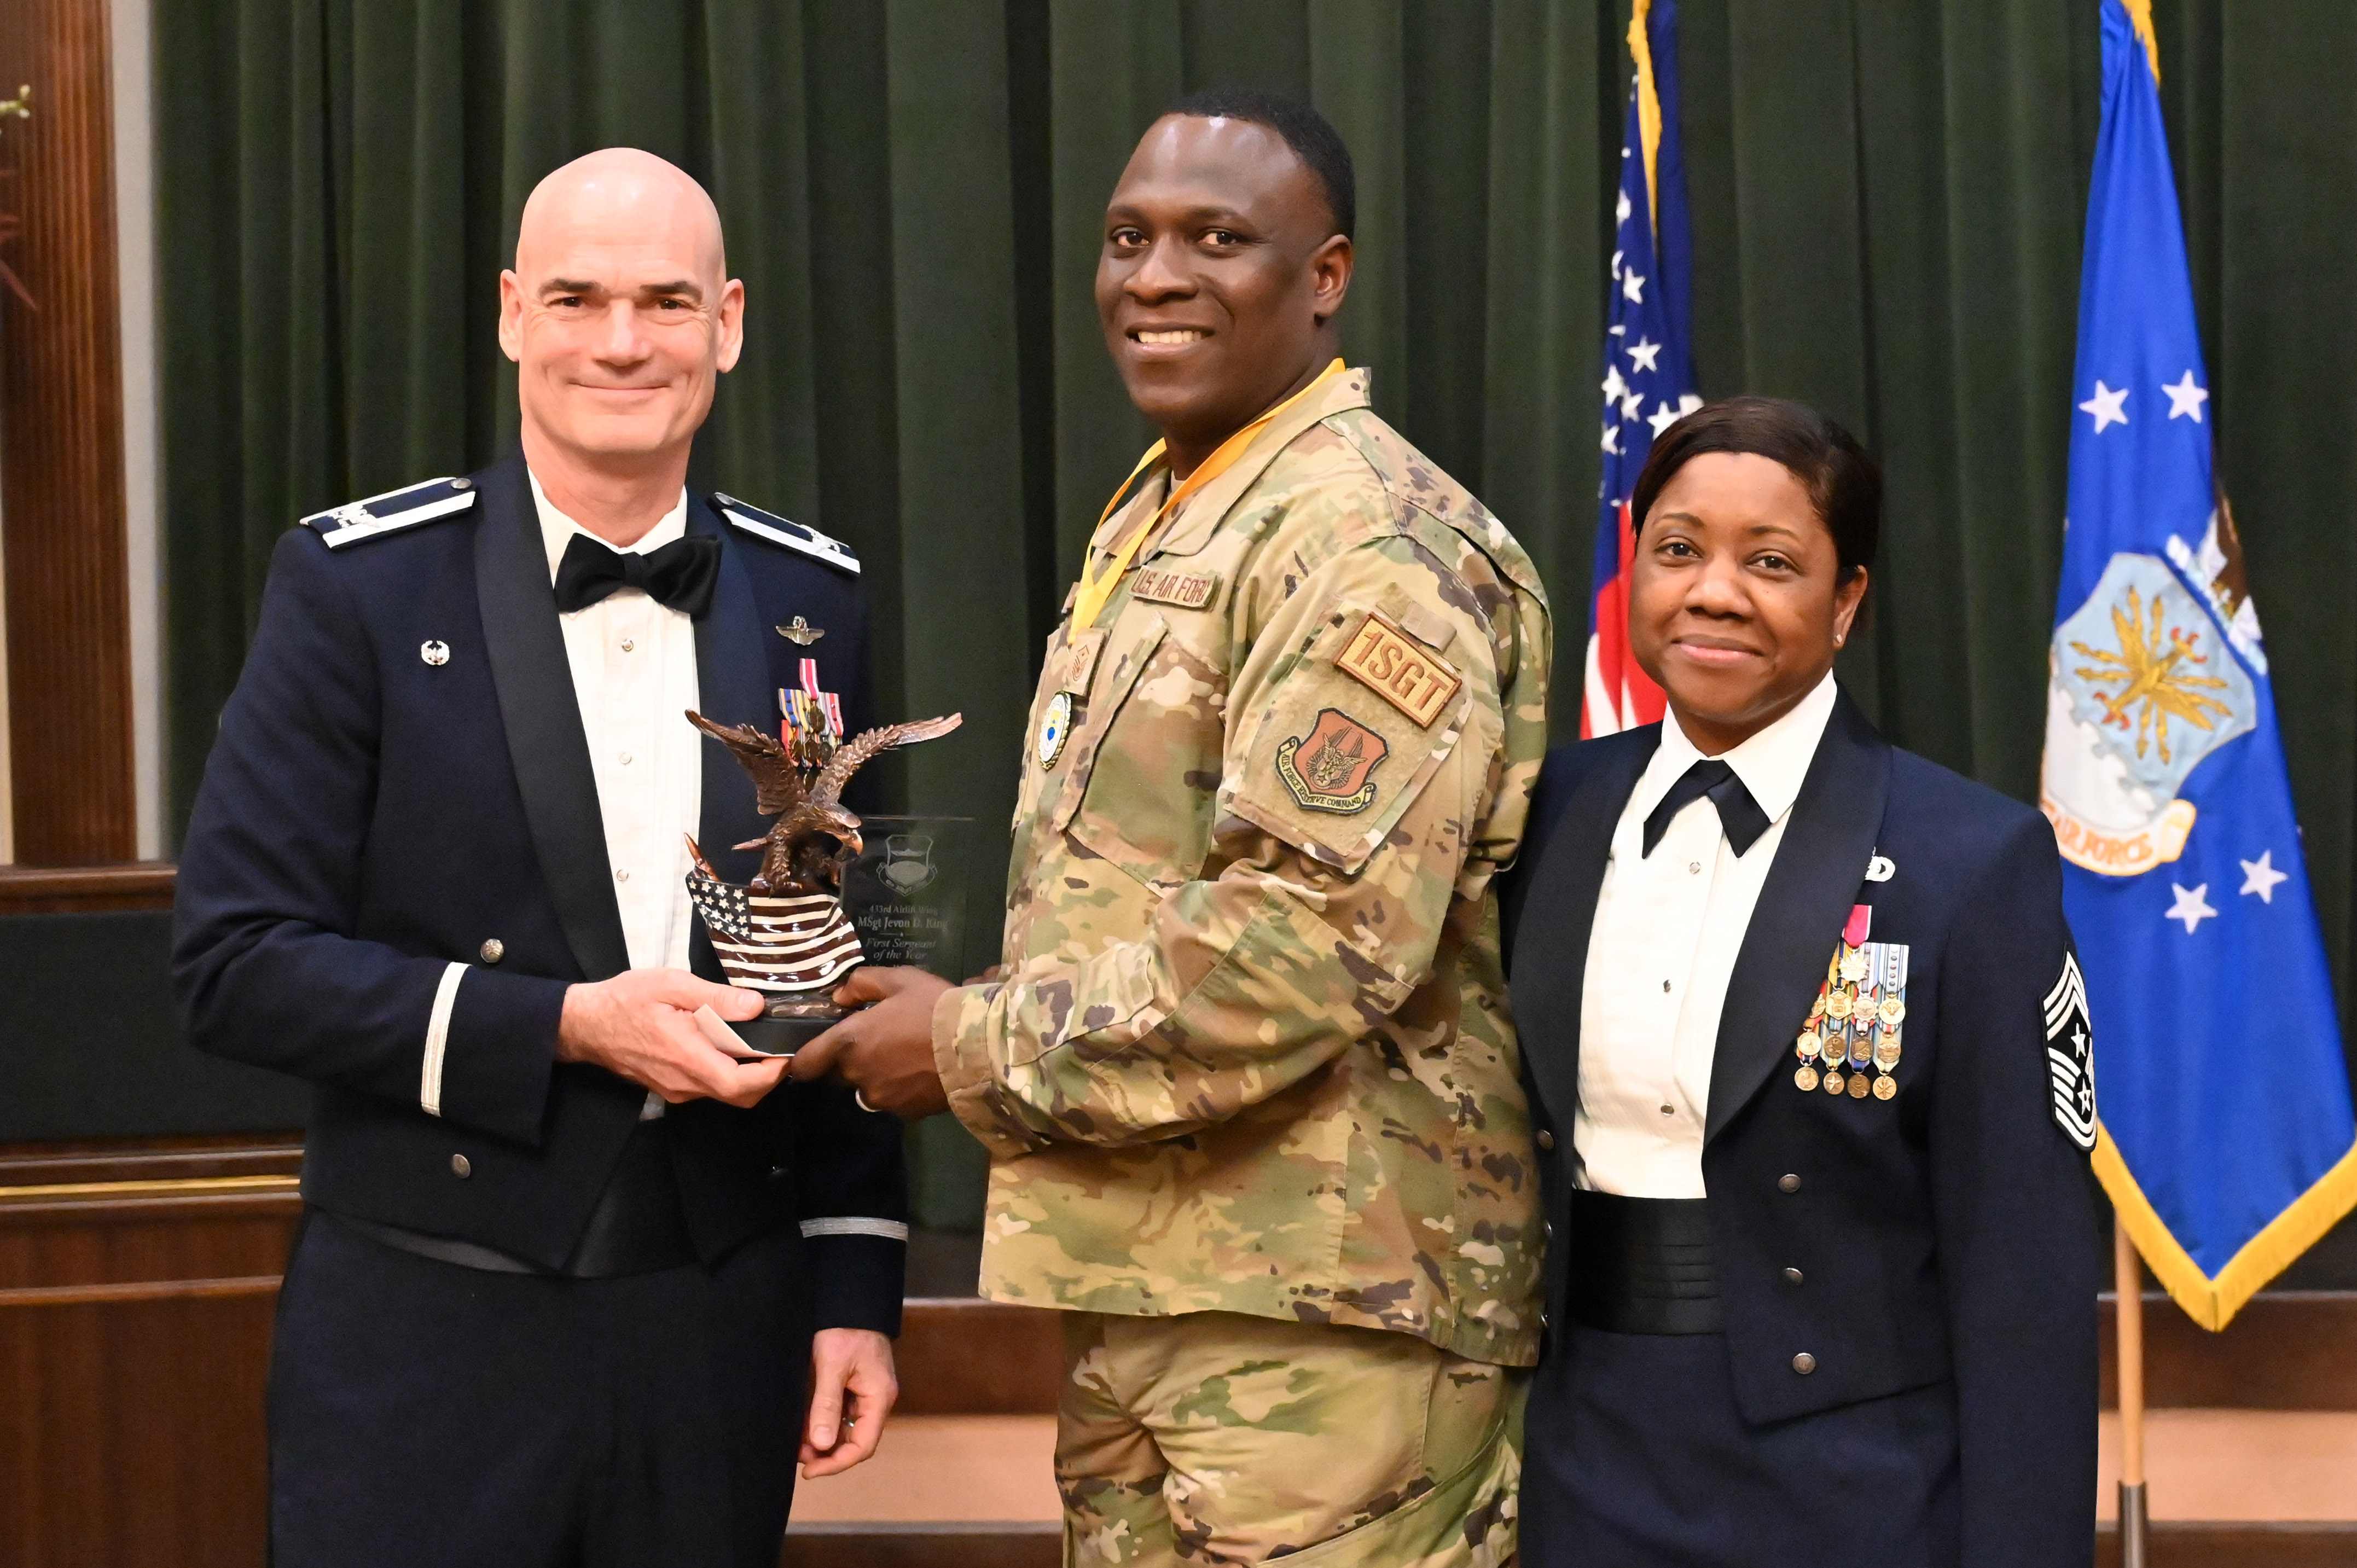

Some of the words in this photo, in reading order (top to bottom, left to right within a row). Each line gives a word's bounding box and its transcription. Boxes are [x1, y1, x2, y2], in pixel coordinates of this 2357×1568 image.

[1152, 574, 1179, 598] AIR
[1175, 577, 1211, 603] FORC
[1352, 631, 1449, 711] 1SGT
[1281, 754, 1290, 768] AIR
[1284, 768, 1301, 788] FORCE
[1297, 785, 1326, 804] RESERVE
[1327, 796, 1361, 808] COMMAND
[869, 904, 892, 914] 433rd
[893, 904, 916, 914] Airlift
[857, 916, 882, 931] MSgt
[884, 916, 910, 930] Jevon
[925, 917, 948, 932] King
[866, 937, 891, 948] First
[893, 938, 936, 950] Sergeant
[874, 950, 886, 961] of
[886, 949, 902, 959] the
[906, 950, 927, 960] Year
